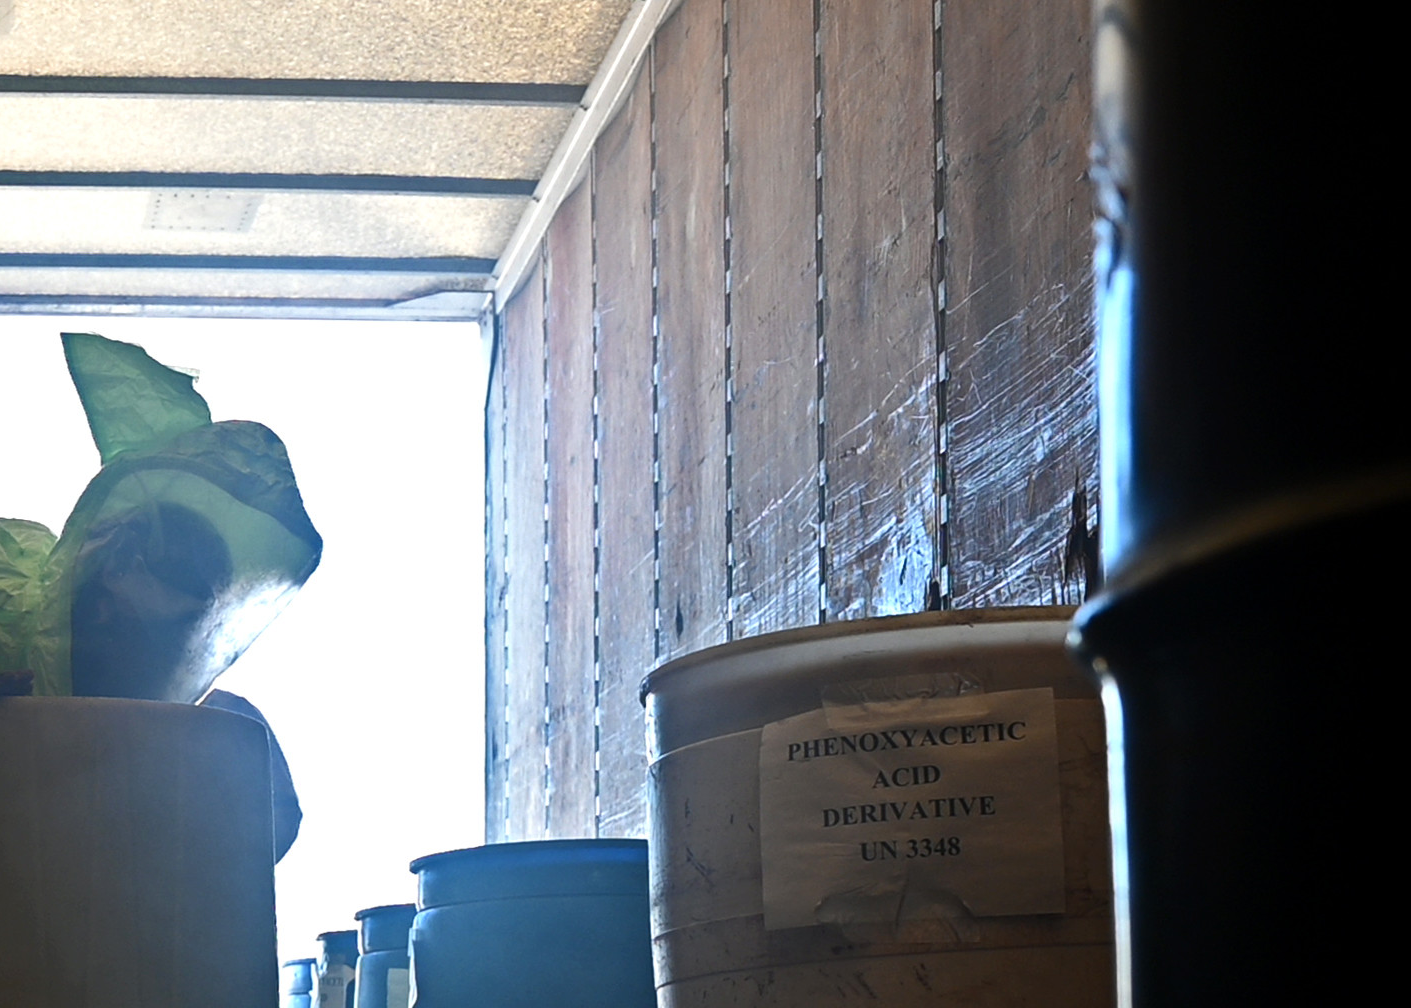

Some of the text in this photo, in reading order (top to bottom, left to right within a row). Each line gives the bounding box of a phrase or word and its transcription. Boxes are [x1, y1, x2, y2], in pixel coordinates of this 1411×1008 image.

[788, 721, 1026, 762] PHENOXYACETIC
[872, 765, 941, 789] ACID
[822, 796, 996, 828] DERIVATIVE
[860, 837, 961, 862] UN 3348
